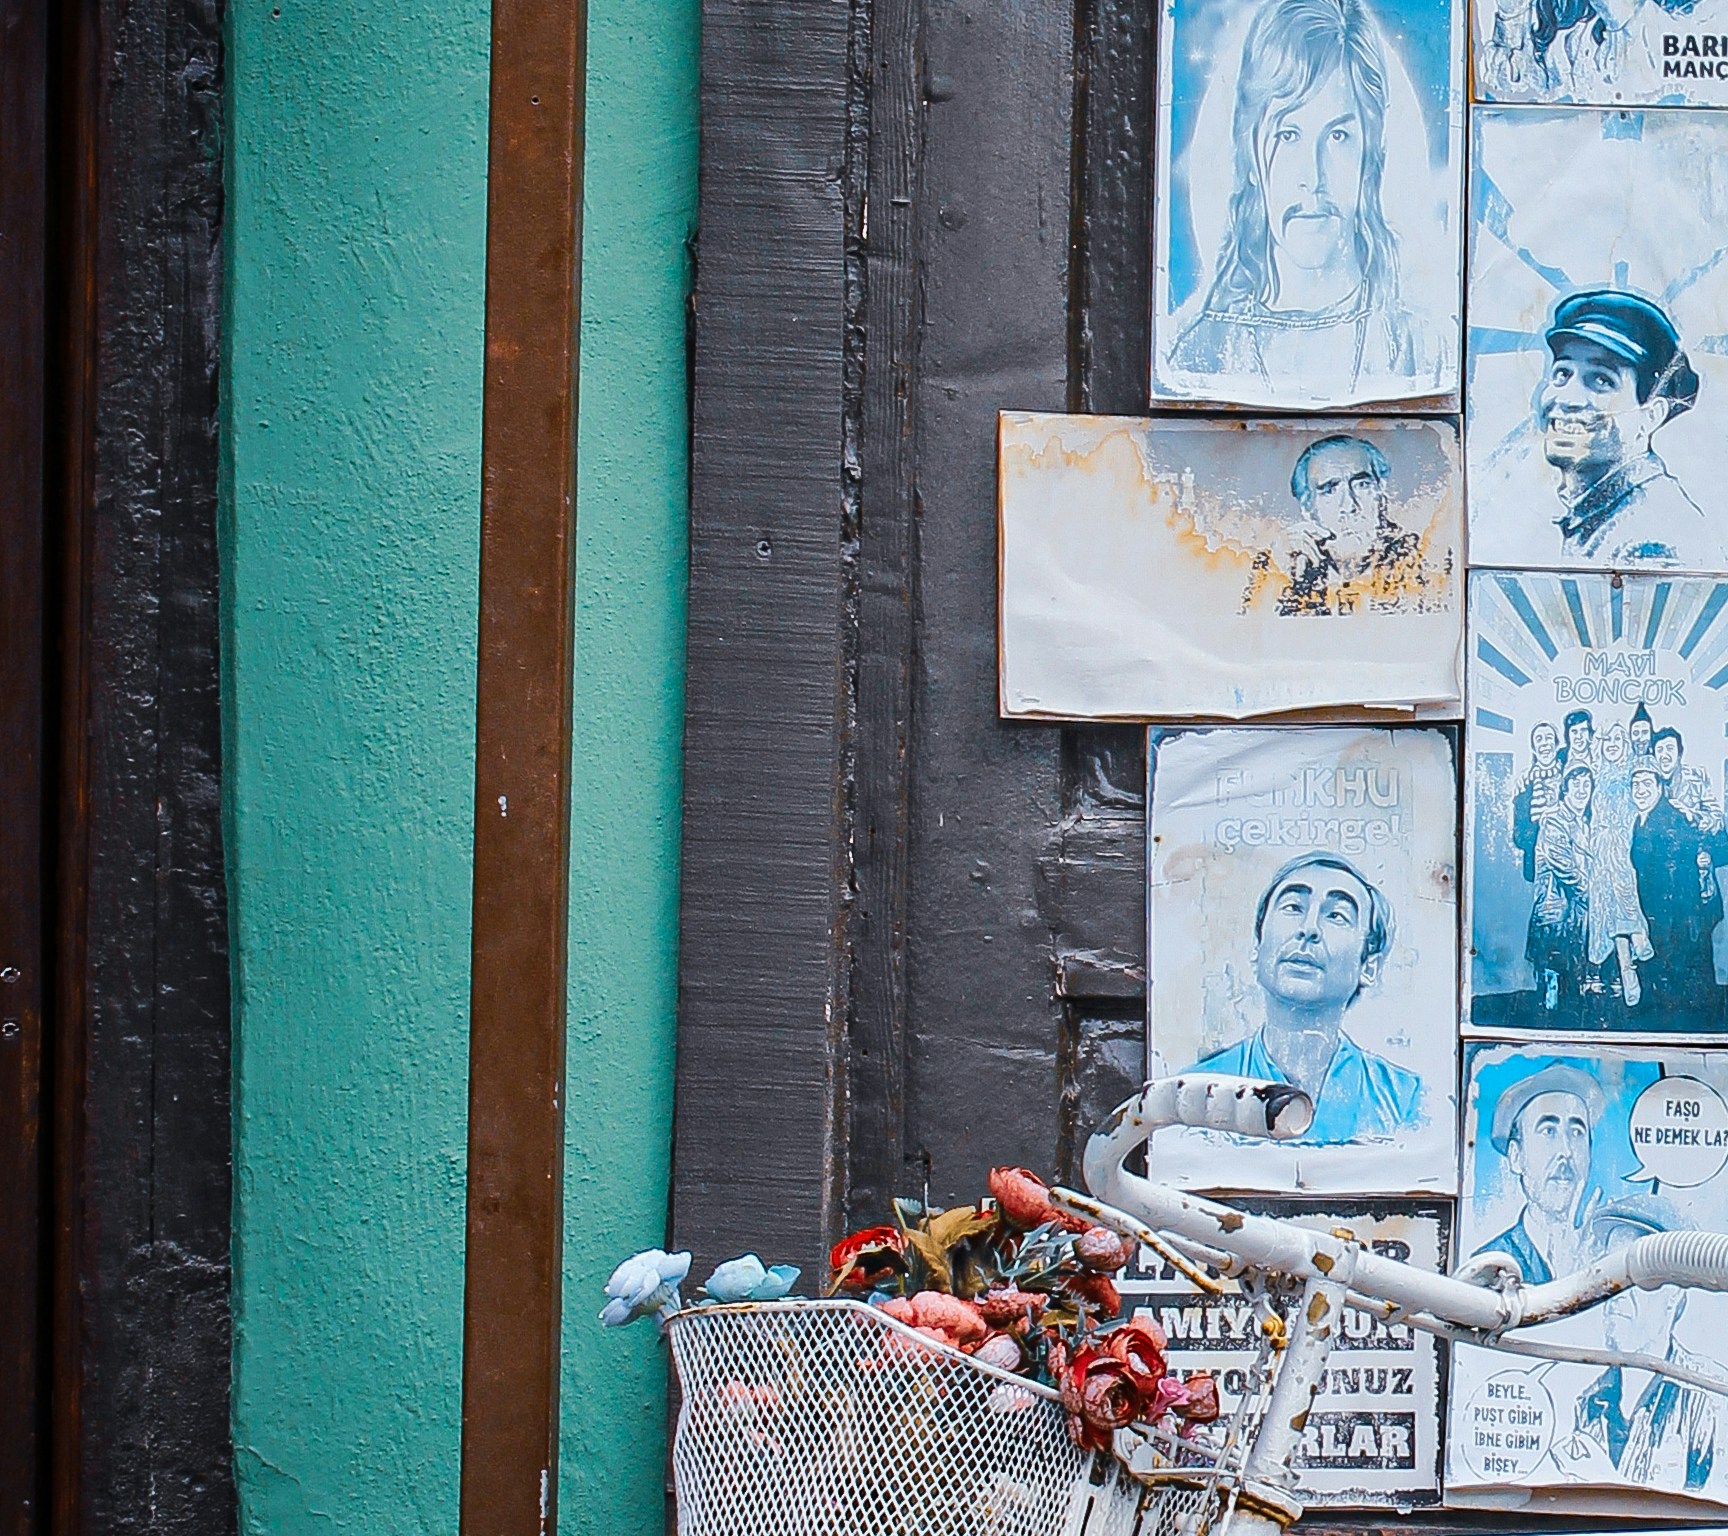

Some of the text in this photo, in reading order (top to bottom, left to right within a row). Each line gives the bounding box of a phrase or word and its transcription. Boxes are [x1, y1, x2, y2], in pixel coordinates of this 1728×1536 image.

[1584, 649, 1656, 677] MAVİ
[1553, 676, 1687, 706] BONCUK
[1215, 810, 1402, 854] çekirge!
[1666, 1100, 1701, 1122] FAŞO
[1634, 1126, 1652, 1144] NE
[1656, 1127, 1701, 1146] DEMEK
[1474, 1404, 1543, 1427] PUŞT GİBİM
[1474, 1426, 1541, 1451] İBNE GİBİM
